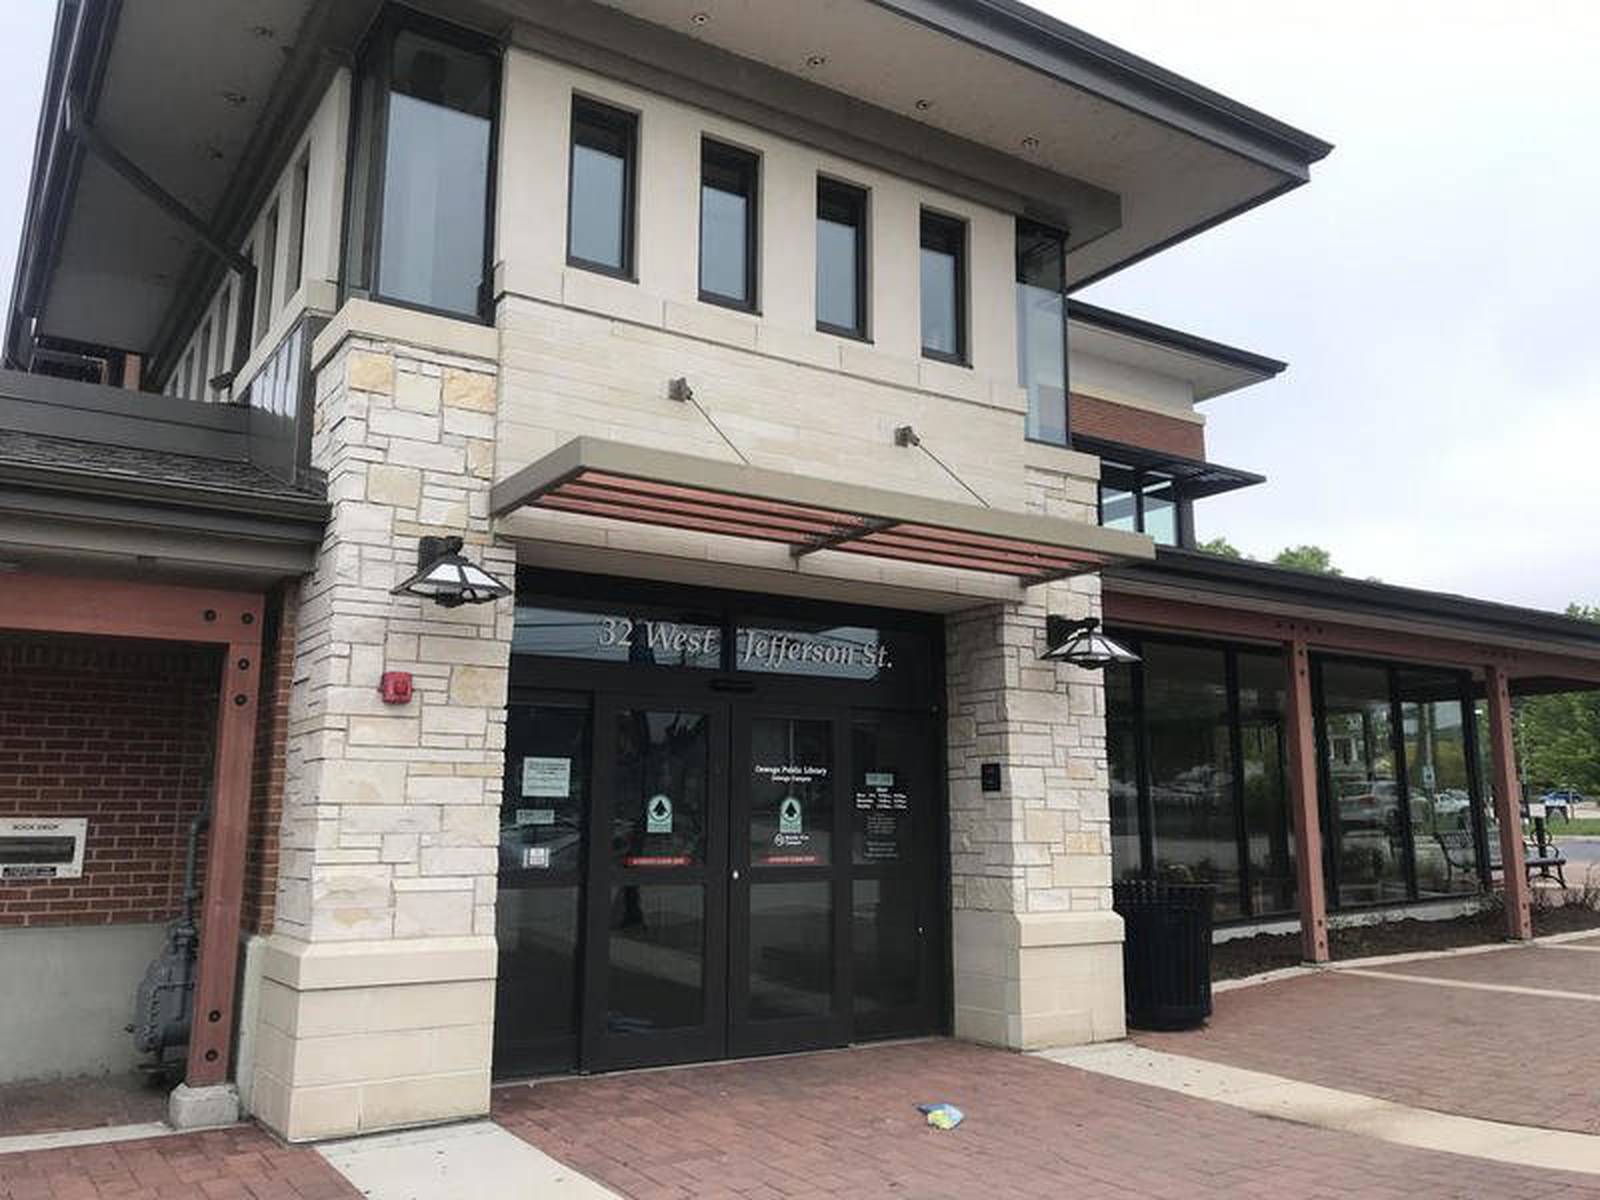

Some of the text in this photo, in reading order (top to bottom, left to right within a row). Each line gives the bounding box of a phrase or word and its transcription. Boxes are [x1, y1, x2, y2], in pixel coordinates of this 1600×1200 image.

[599, 618, 893, 669] 32 West Jefferson St.
